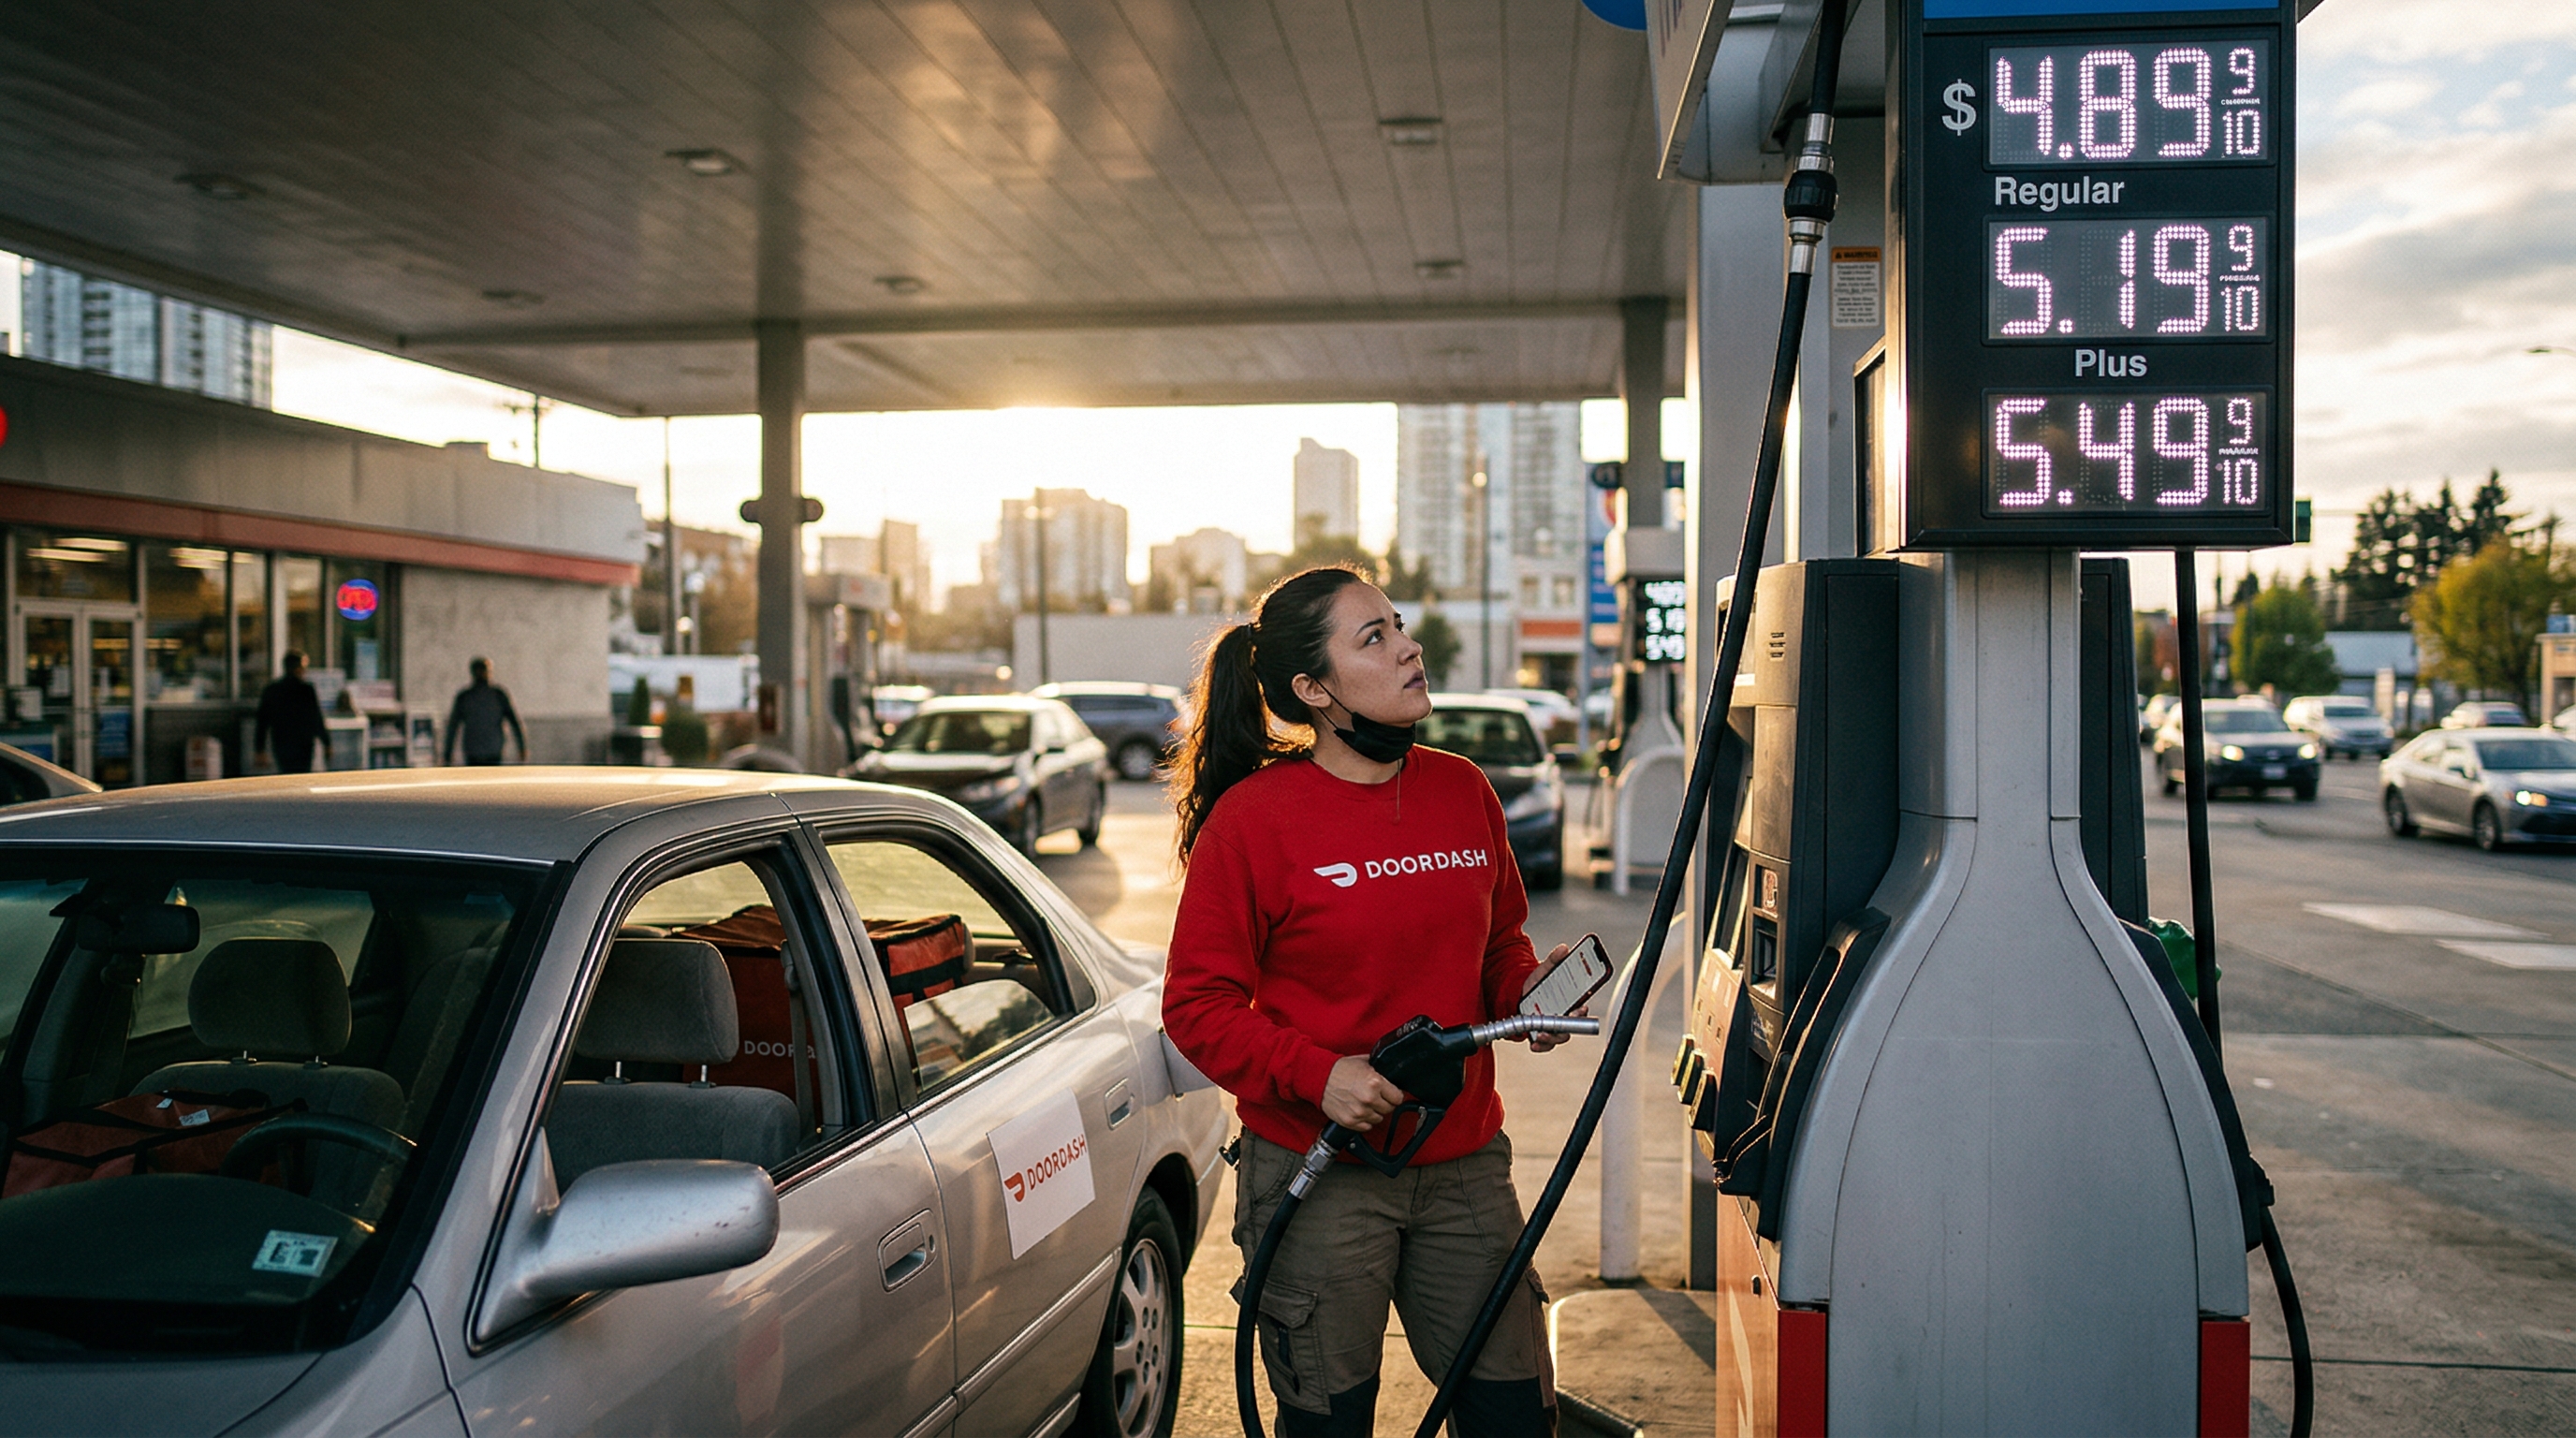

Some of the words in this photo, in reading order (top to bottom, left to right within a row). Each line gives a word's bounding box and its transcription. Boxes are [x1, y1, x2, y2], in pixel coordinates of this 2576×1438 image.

[1942, 80, 1976, 136] $
[1996, 49, 2211, 159] 4.89
[2229, 48, 2255, 95] 9
[2222, 109, 2261, 156] 10
[1995, 176, 2125, 212] Regular
[1996, 225, 2210, 335] 5.19
[2228, 225, 2253, 271] 9
[2220, 285, 2259, 332] 10
[2075, 349, 2147, 377] Plus
[1996, 398, 2209, 506] 5.49
[2227, 397, 2252, 445] 9
[2223, 458, 2258, 506] 10
[1365, 849, 1488, 878] DOORDASH
[1027, 1134, 1087, 1190] DOORDASH
